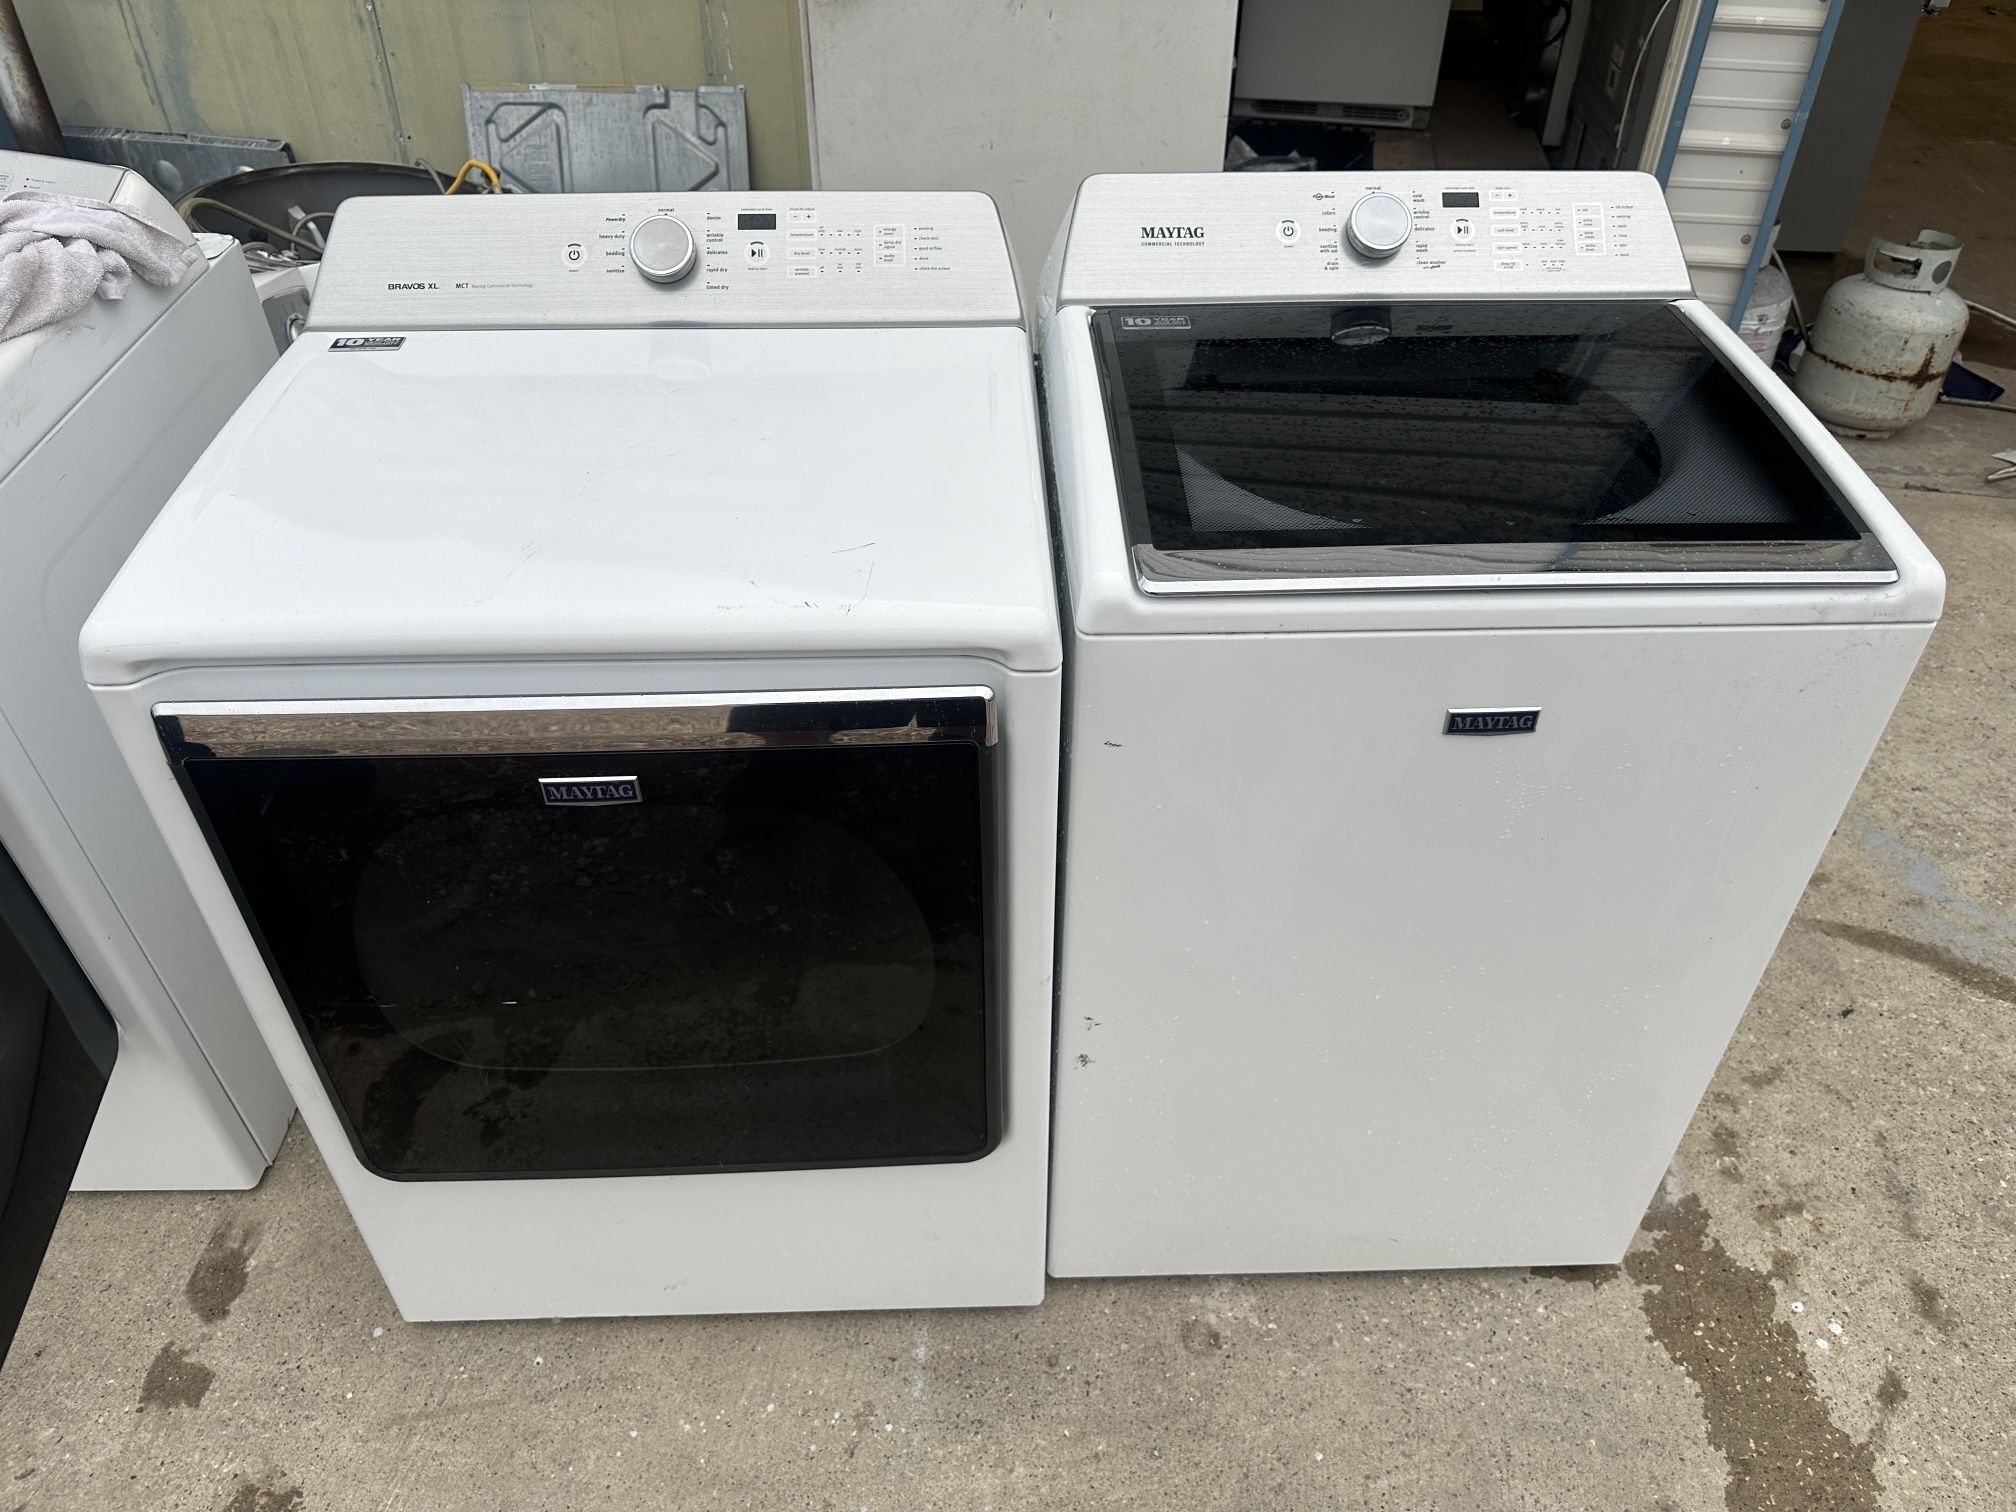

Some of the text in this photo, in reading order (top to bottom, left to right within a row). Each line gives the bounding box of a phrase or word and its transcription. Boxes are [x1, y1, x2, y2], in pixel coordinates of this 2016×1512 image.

[1141, 227, 1205, 238] MAYTAG
[1125, 317, 1152, 325] 10
[1452, 715, 1533, 729] MAYTAG
[546, 784, 633, 799] MAYTAG
